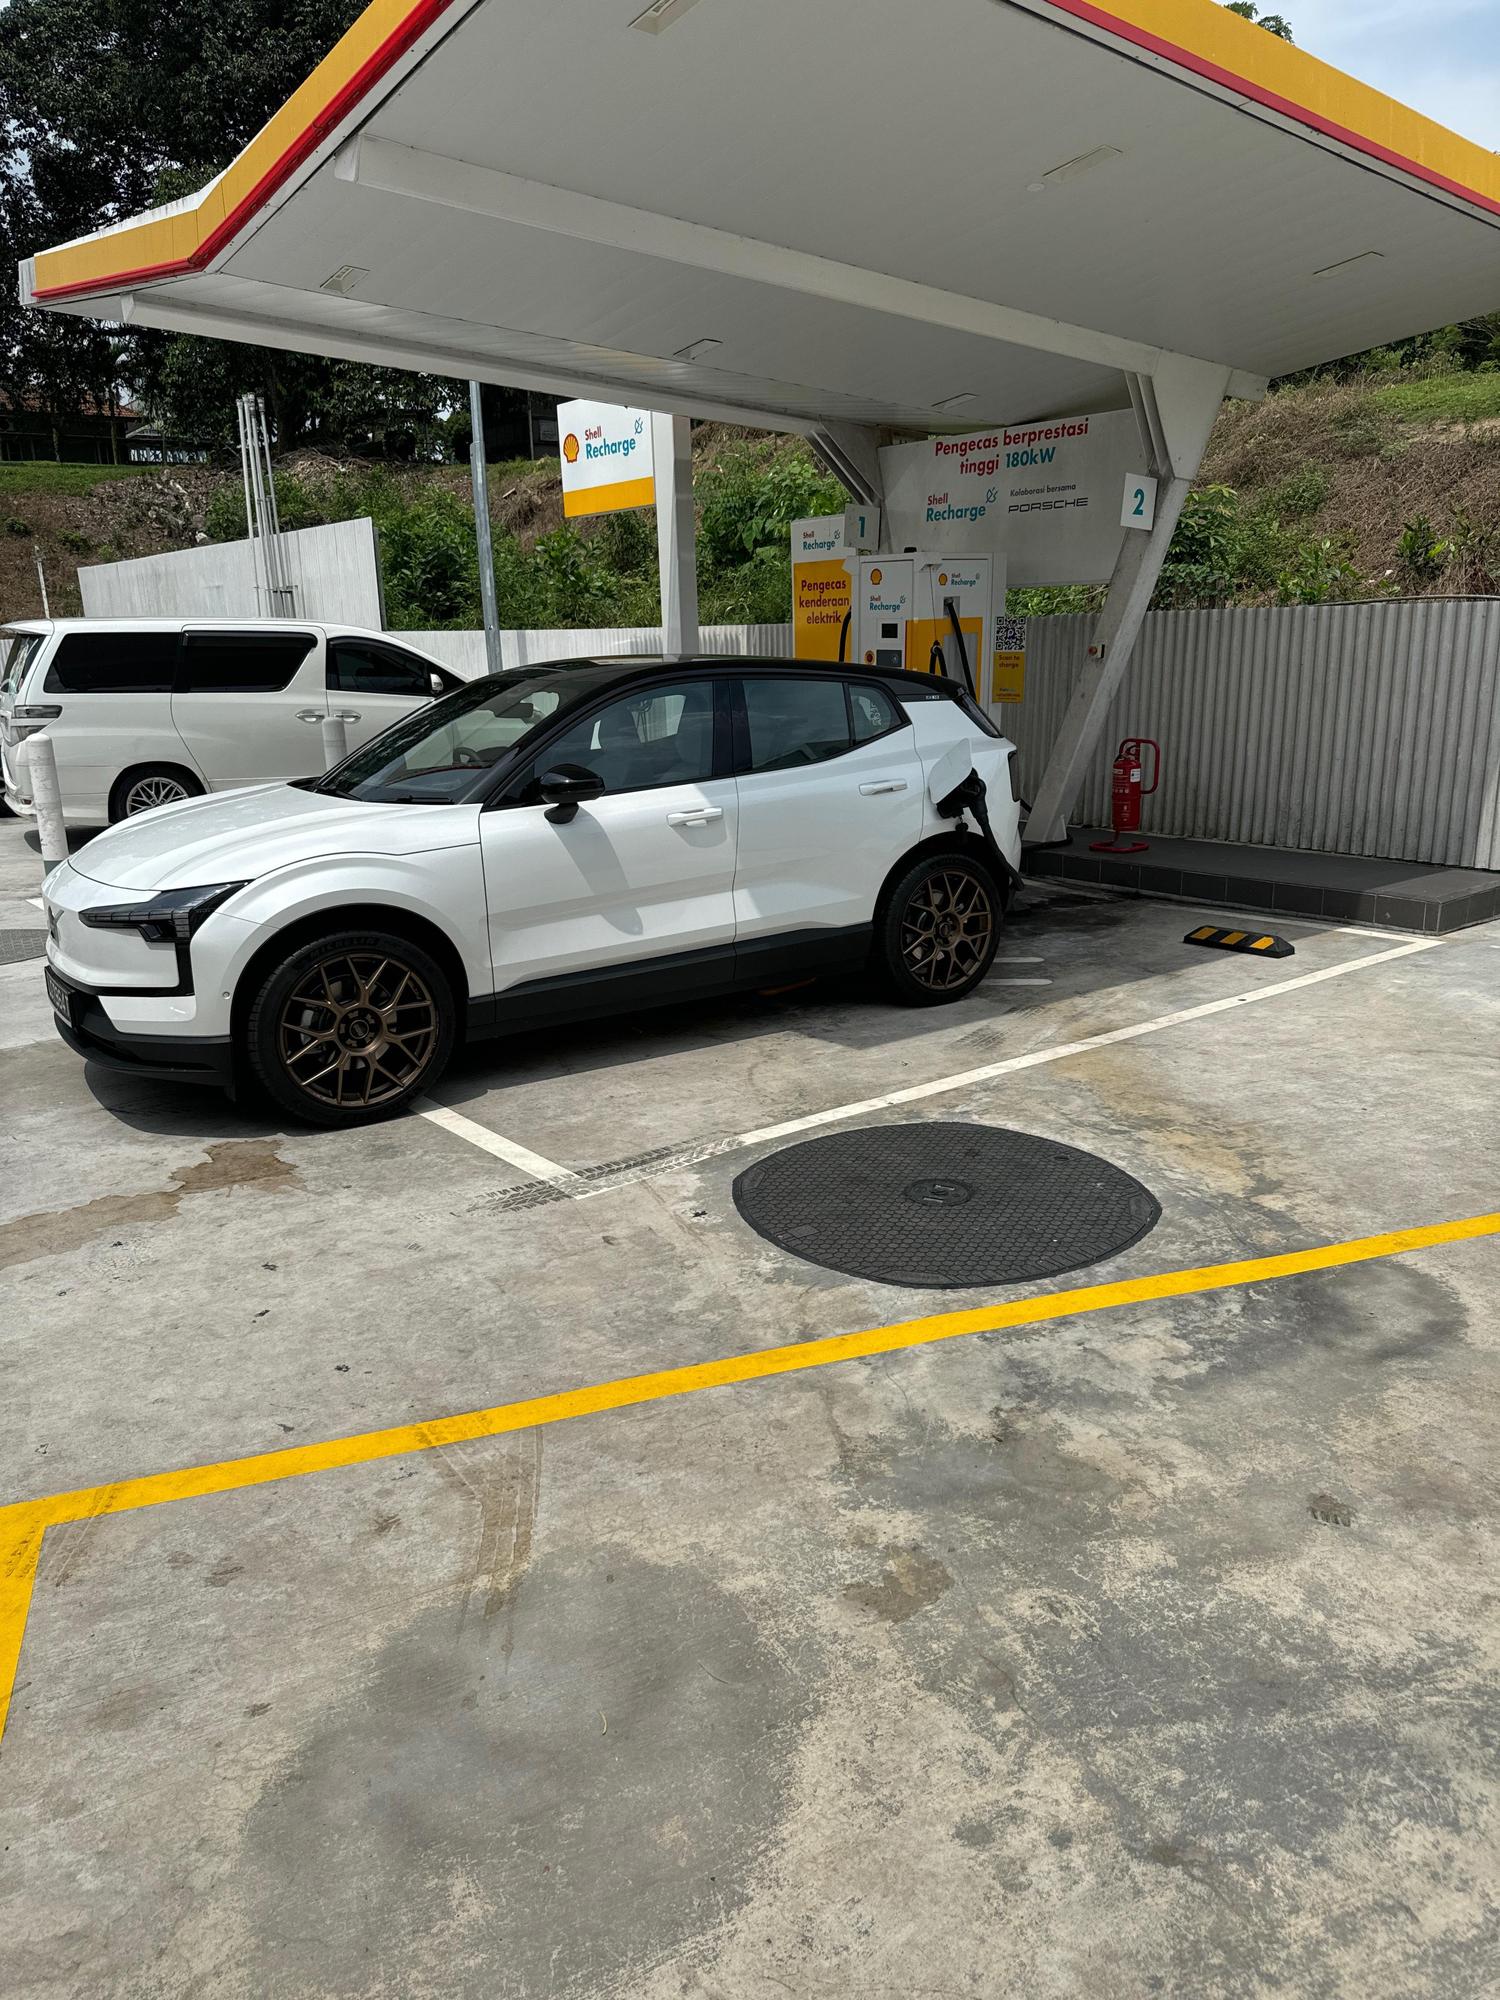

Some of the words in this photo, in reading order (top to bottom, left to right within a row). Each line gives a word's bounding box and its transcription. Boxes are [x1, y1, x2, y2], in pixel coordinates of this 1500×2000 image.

[585, 426, 602, 440] Shell
[935, 435, 998, 456] Pengecas
[1003, 418, 1089, 446] berprestasi
[585, 438, 636, 459] Recharge
[960, 454, 999, 476] tinggi
[1006, 447, 1056, 469] 180kW
[1010, 485, 1045, 497] Kolaborasi
[1046, 483, 1076, 494] bersama
[927, 492, 948, 506] Shell
[1008, 498, 1088, 514] PORSCHE
[1132, 488, 1145, 515] 2
[926, 504, 986, 522] Recharge
[857, 516, 866, 538] 1
[802, 531, 815, 539] Shell
[803, 540, 836, 550] Recharge
[801, 579, 847, 594] Pengecas
[950, 578, 977, 587] Recharge
[799, 595, 850, 608] kenderaan
[869, 602, 901, 612] Recharge
[806, 611, 842, 625] elektrik
